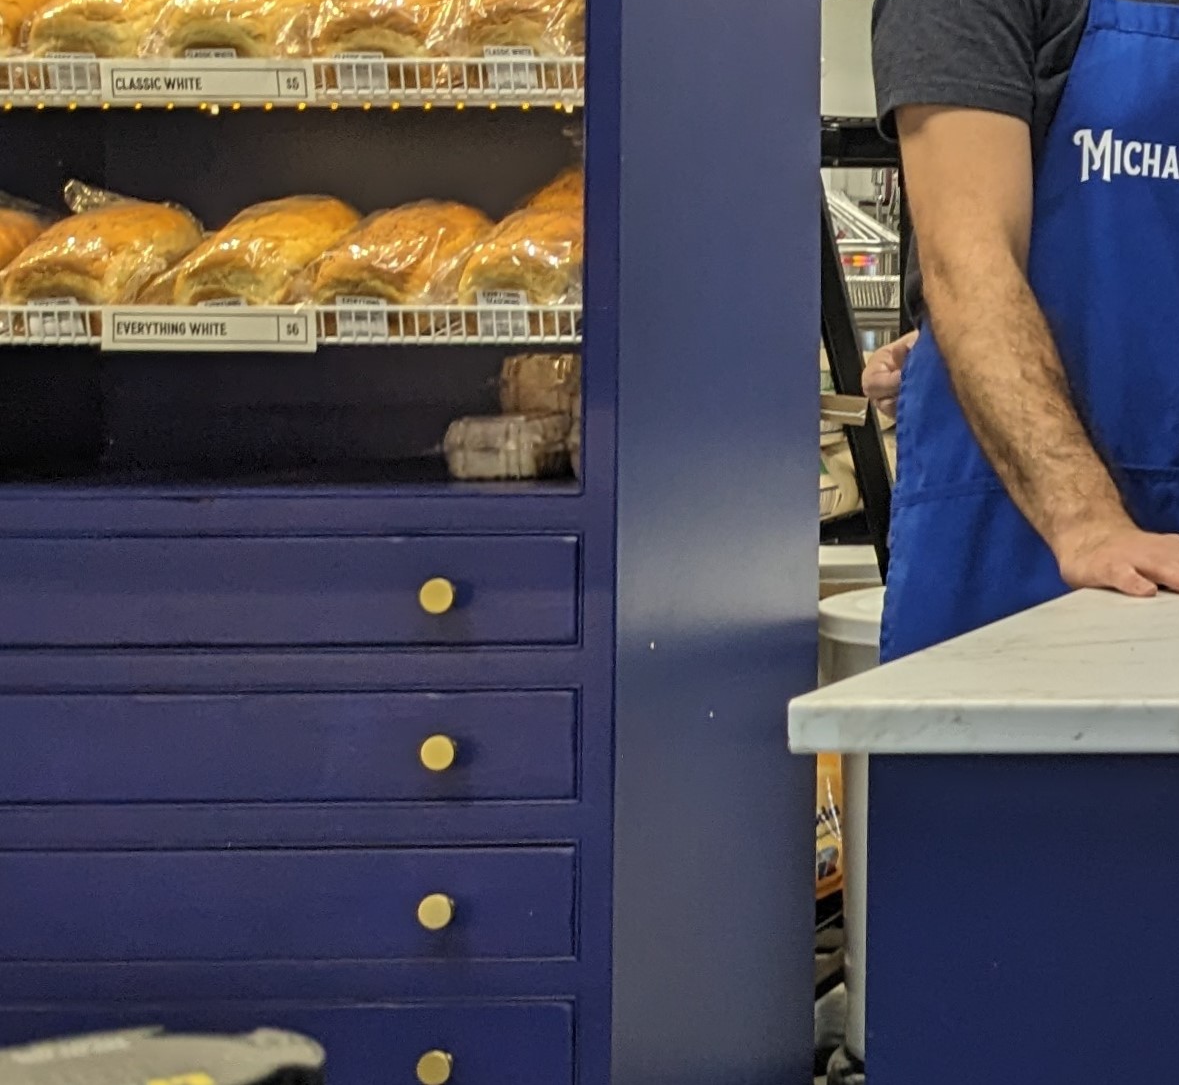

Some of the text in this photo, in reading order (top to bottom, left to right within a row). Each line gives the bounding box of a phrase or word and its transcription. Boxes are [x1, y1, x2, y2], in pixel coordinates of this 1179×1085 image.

[115, 76, 162, 91] CLASSIC
[164, 76, 203, 91] WHITE
[116, 322, 186, 336] EVERYTHING
[189, 322, 227, 336] WHITE
